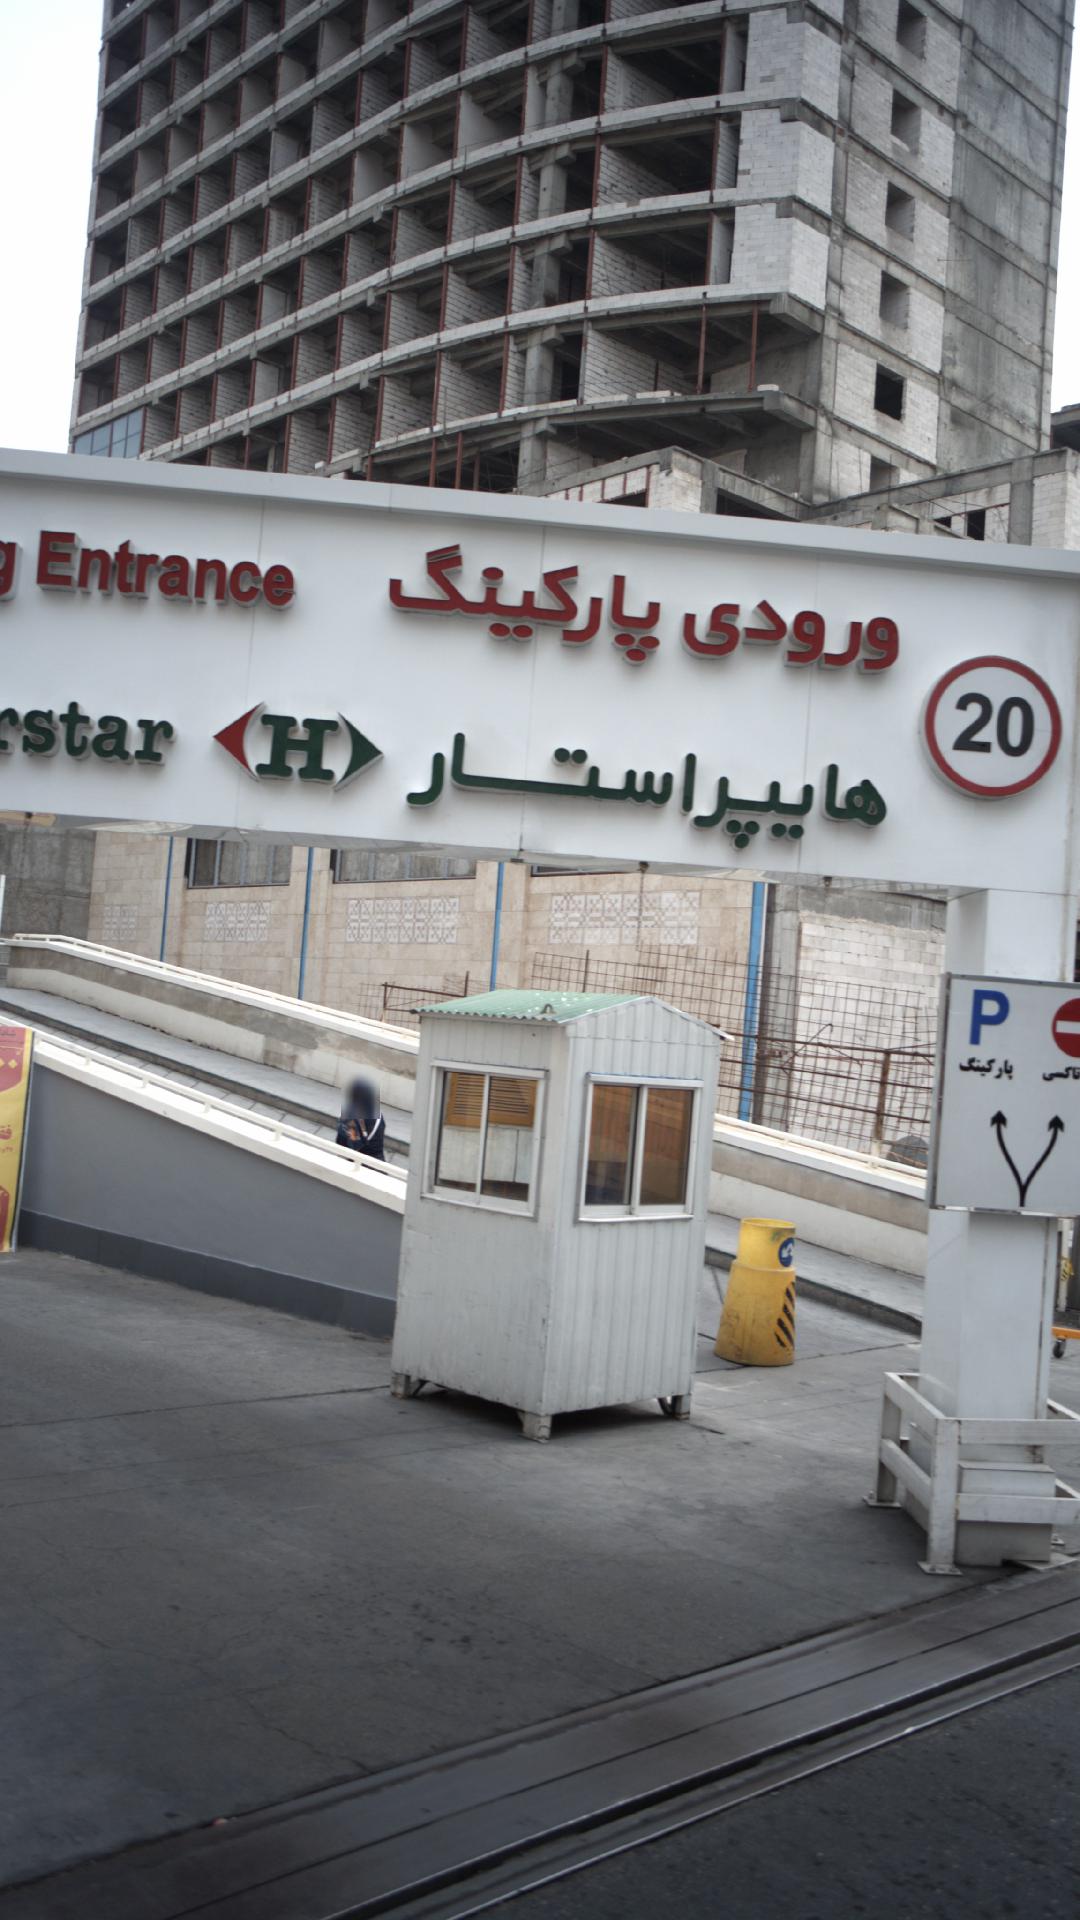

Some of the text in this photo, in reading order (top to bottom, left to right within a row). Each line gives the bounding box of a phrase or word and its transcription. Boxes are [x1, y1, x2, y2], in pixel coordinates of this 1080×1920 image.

[37, 530, 295, 606] Entrance
[388, 543, 899, 671] ورودی پارکینگ
[256, 713, 340, 782] H
[952, 692, 1034, 758] 20
[406, 733, 887, 849] هایپراستار
[969, 989, 1011, 1046] P
[959, 1056, 1013, 1080] پارکینگ
